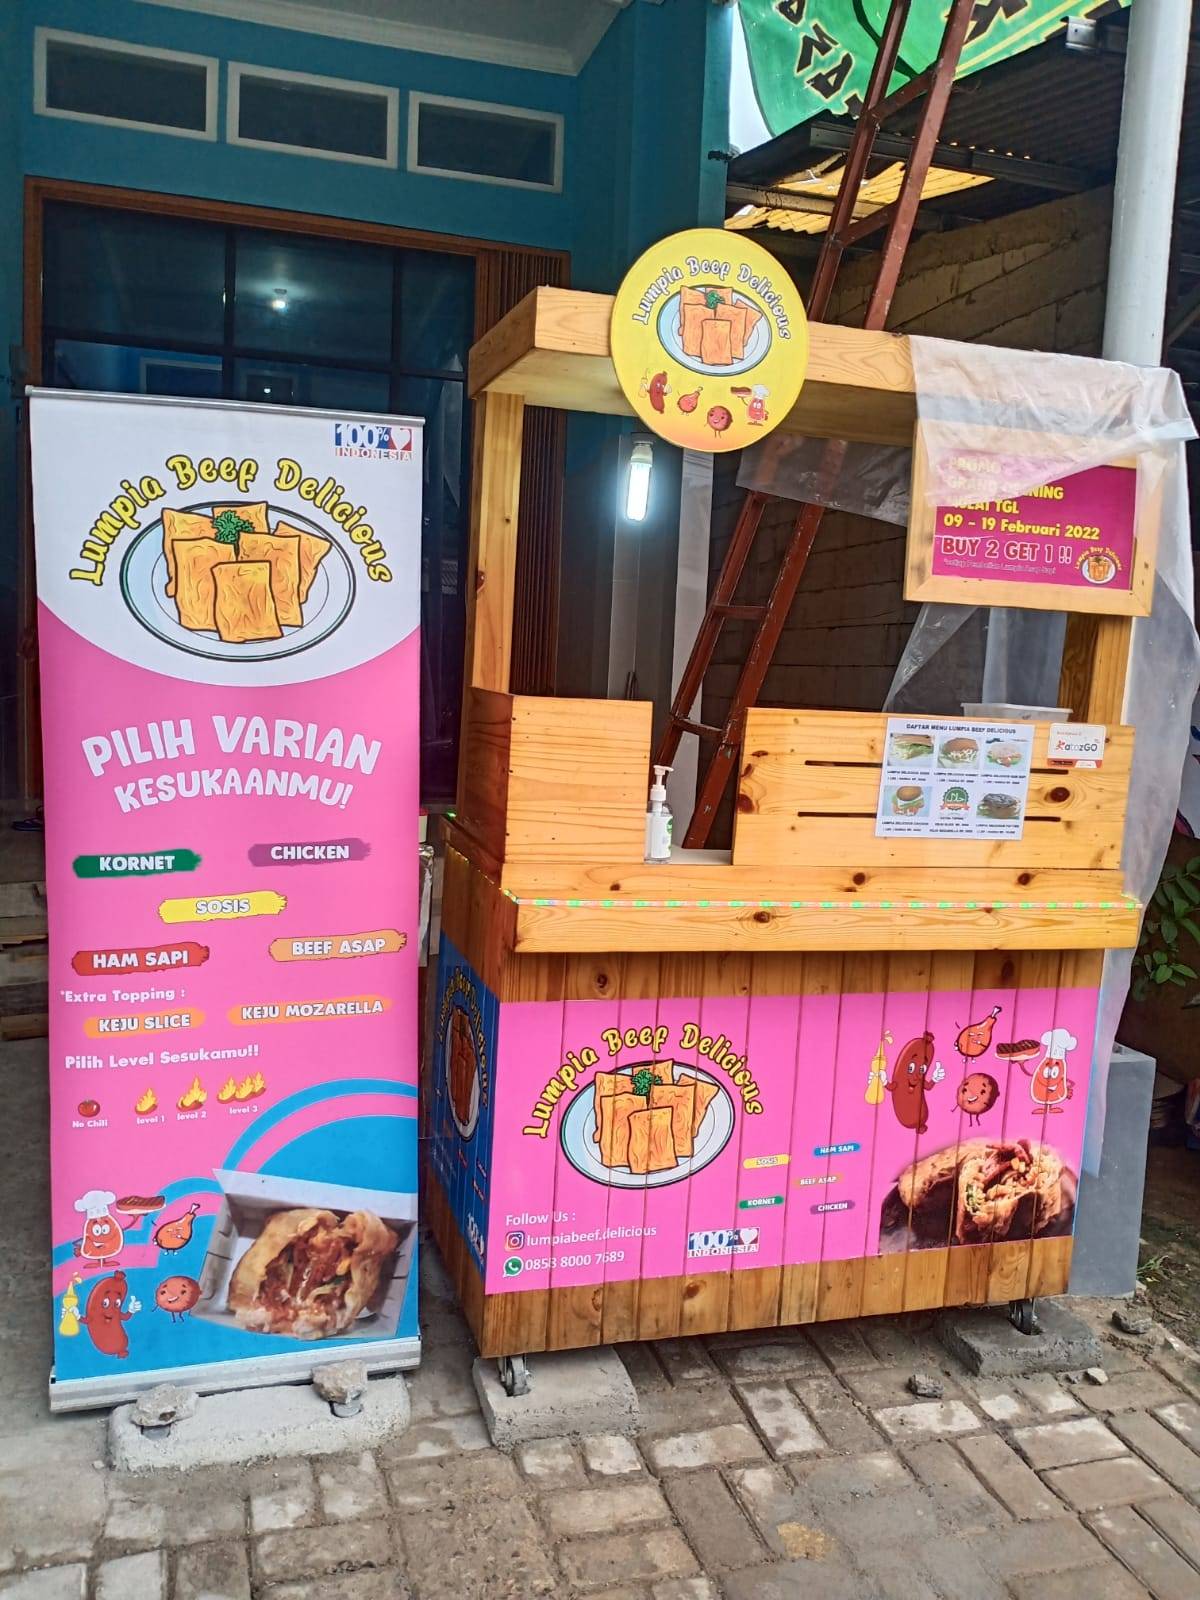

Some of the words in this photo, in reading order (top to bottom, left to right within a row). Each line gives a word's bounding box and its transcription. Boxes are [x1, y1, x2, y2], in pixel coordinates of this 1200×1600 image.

[632, 266, 683, 325] Lumpia
[685, 256, 731, 281] Beef
[737, 263, 792, 340] Delicious
[335, 447, 412, 461] INDONESIA
[995, 500, 1020, 514] TGL
[69, 476, 166, 586] Lumpia
[166, 454, 259, 493] Beef
[274, 458, 392, 584] Delicious
[943, 513, 963, 527] 09
[981, 517, 996, 531] 19
[1000, 518, 1060, 537] Februari
[1064, 525, 1100, 540] 2022
[941, 535, 982, 557] BUY
[985, 539, 999, 559] 2
[1004, 541, 1040, 561] GET
[1044, 545, 1053, 563] 1
[1058, 546, 1073, 564] !!
[81, 719, 196, 777] PILIH
[212, 716, 382, 775] VARIAN
[114, 768, 353, 813] KESUKAANMU!
[270, 845, 350, 861] CHICKEN
[99, 855, 175, 872] KORNET
[195, 899, 250, 914] SOSIS
[292, 940, 332, 956] BEEF
[339, 938, 386, 954] ASAP
[93, 953, 139, 969] HAM
[145, 950, 189, 966] SAPI
[112, 988, 175, 1002] Topping
[241, 1006, 280, 1020] KEJU
[285, 1000, 384, 1017] MOZARELLA
[98, 1019, 139, 1033] KEJU
[144, 1014, 191, 1029] SLICE
[65, 1055, 103, 1069] Pilih
[109, 1052, 154, 1068] Level
[160, 1045, 259, 1064] Sesukamu!!
[522, 1046, 599, 1138] Lumpia
[601, 1025, 669, 1057] Beef
[679, 1023, 764, 1115] Delicious
[177, 1112, 197, 1121] level
[200, 1111, 207, 1119] 2
[229, 1106, 250, 1115] level
[252, 1105, 258, 1113] 3
[72, 1120, 84, 1129] No
[87, 1119, 108, 1128] Chili
[136, 1116, 157, 1125] level
[160, 1115, 165, 1123] 1
[820, 1146, 836, 1154] HAM
[838, 1145, 854, 1153] SAPI
[756, 1157, 778, 1165] SOSIS
[747, 1198, 776, 1207] KORNET
[817, 1203, 848, 1211] CHICKEN
[506, 1213, 549, 1226] Follow
[553, 1210, 569, 1223] Us
[526, 1226, 657, 1247] lumpiabeef.delicious
[560, 1254, 591, 1268] 8000
[595, 1250, 625, 1265] 7689
[688, 1245, 758, 1257] INDONESIA
